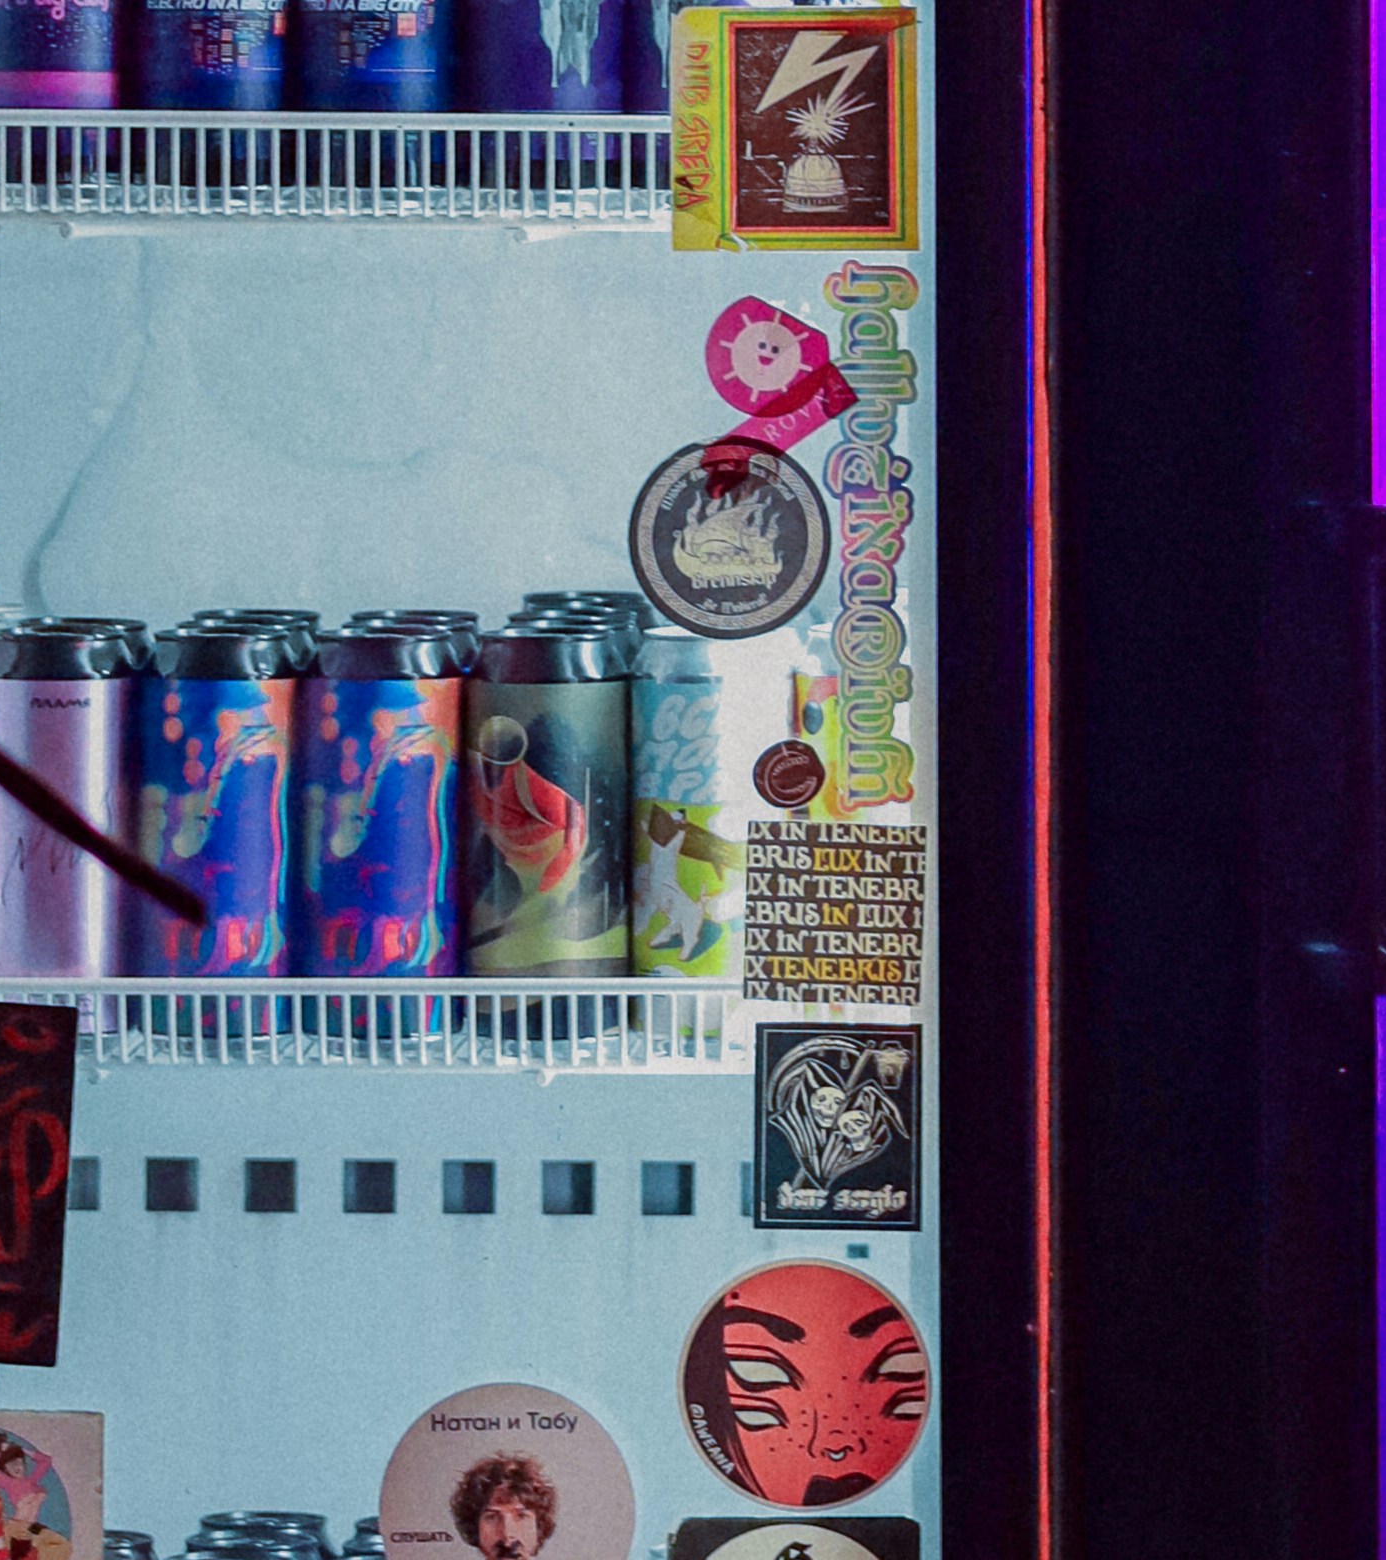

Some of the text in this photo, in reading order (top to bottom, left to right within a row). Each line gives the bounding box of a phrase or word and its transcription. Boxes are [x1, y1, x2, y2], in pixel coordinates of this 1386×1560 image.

[675, 40, 711, 211] DUB SREDA
[813, 847, 863, 873] LUX
[864, 849, 896, 874] IN
[775, 874, 811, 899] IN
[822, 903, 907, 929] IN LUX
[775, 930, 811, 954] IN
[768, 957, 903, 982] TENEBRIS
[430, 1410, 579, 1435] Натан и Табу
